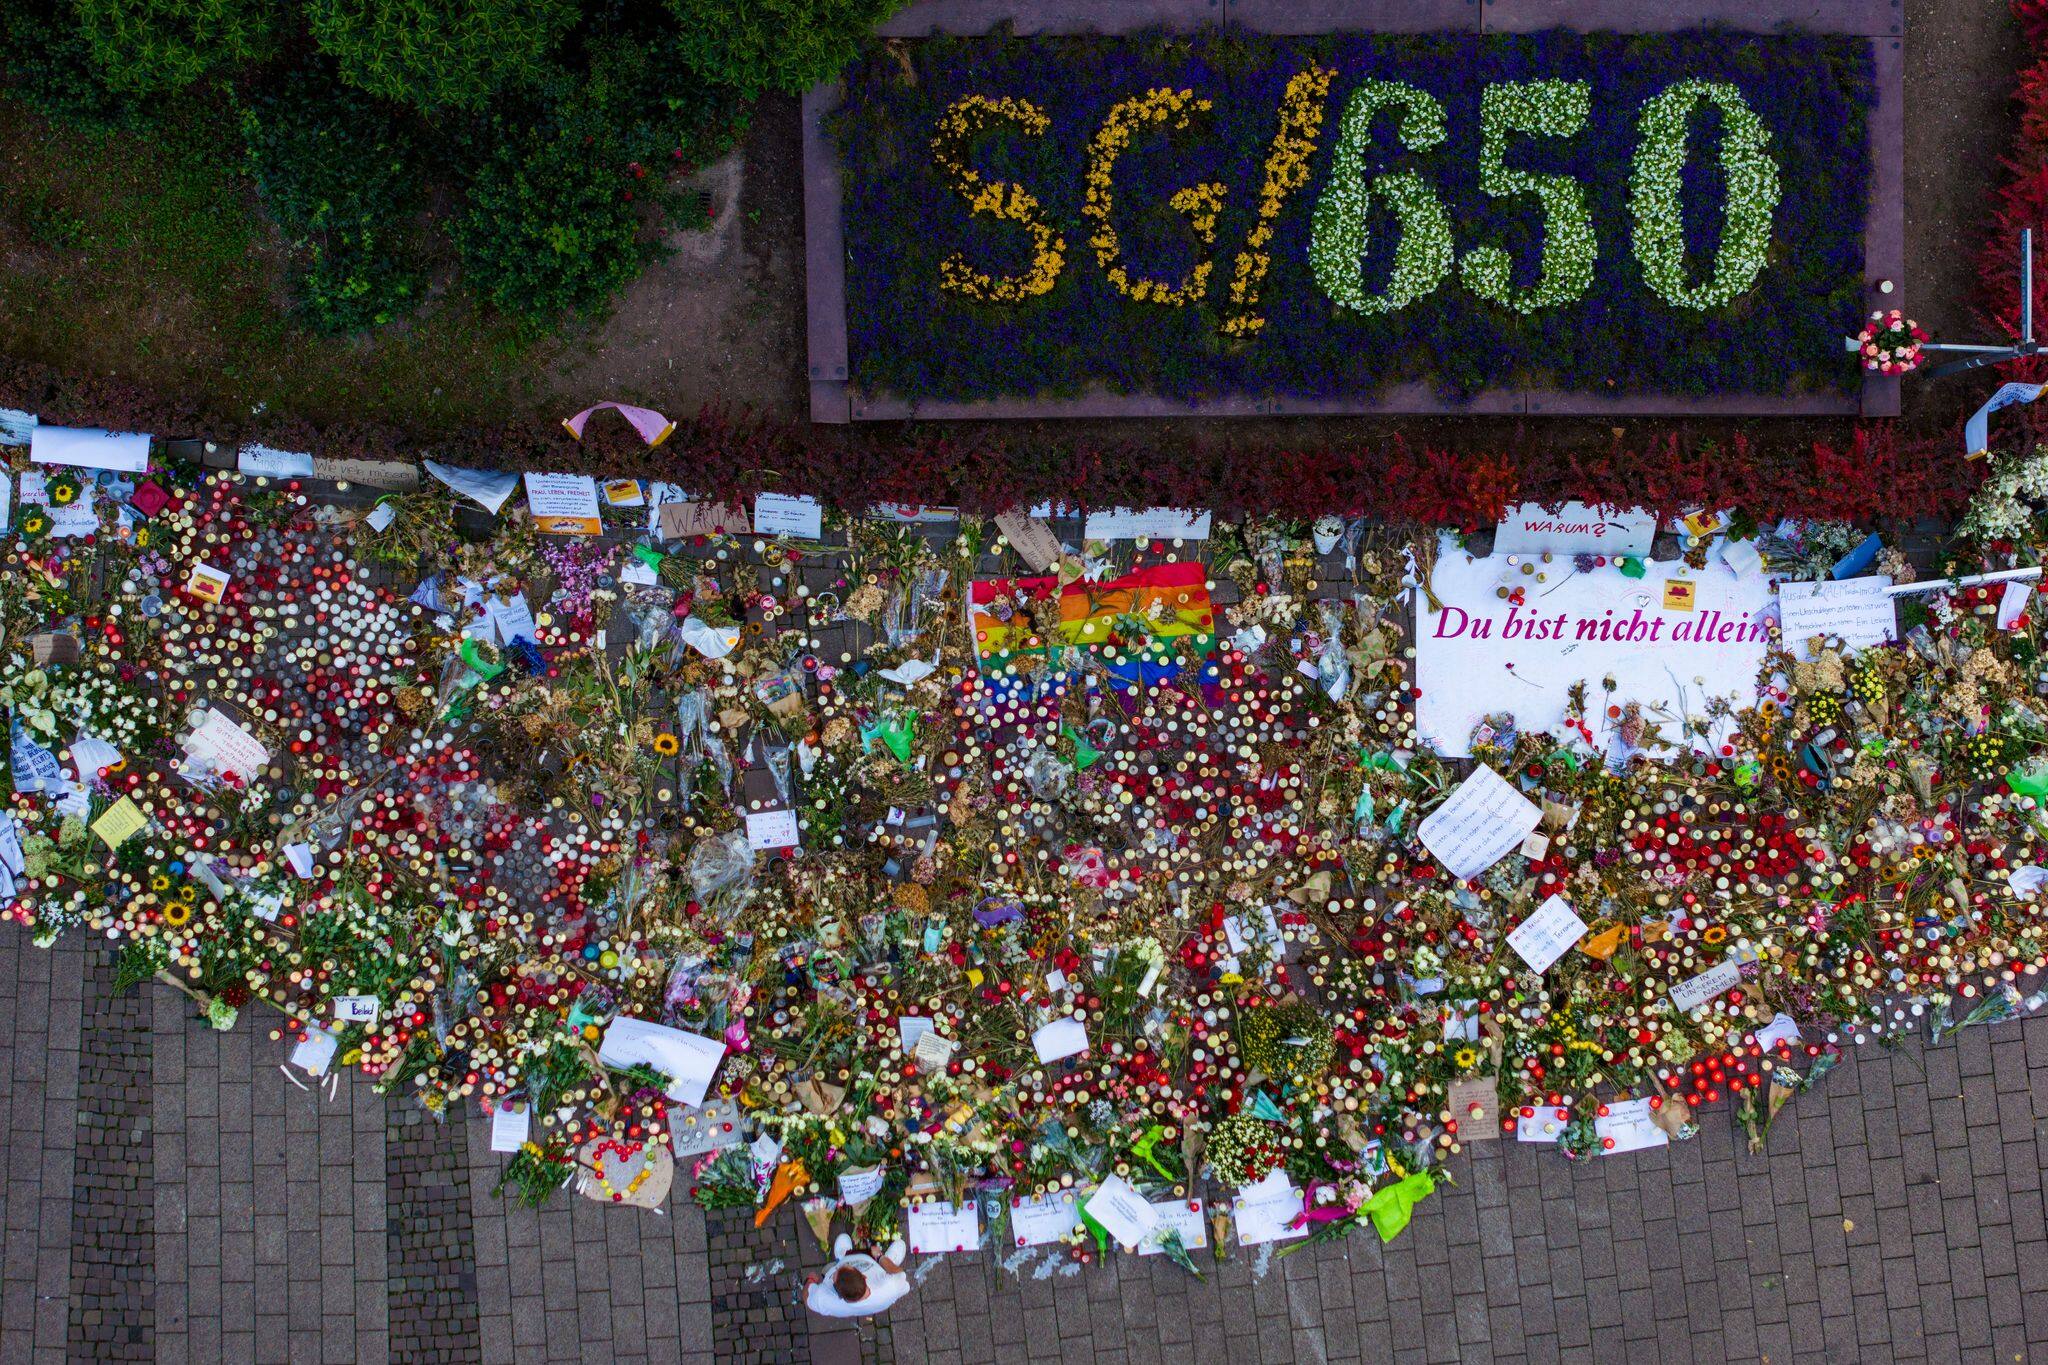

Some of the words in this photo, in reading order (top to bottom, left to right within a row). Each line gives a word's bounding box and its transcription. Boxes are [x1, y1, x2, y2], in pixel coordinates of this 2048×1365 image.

[1524, 521, 1607, 539] WARUM?
[1433, 608, 1491, 638] Du
[1503, 608, 1566, 639] bist
[1577, 610, 1663, 641] nicht
[1671, 980, 1695, 994] NICHT
[1699, 973, 1709, 981] IN
[1680, 972, 1727, 998] UNSEREM
[1701, 975, 1738, 996] NAMEN
